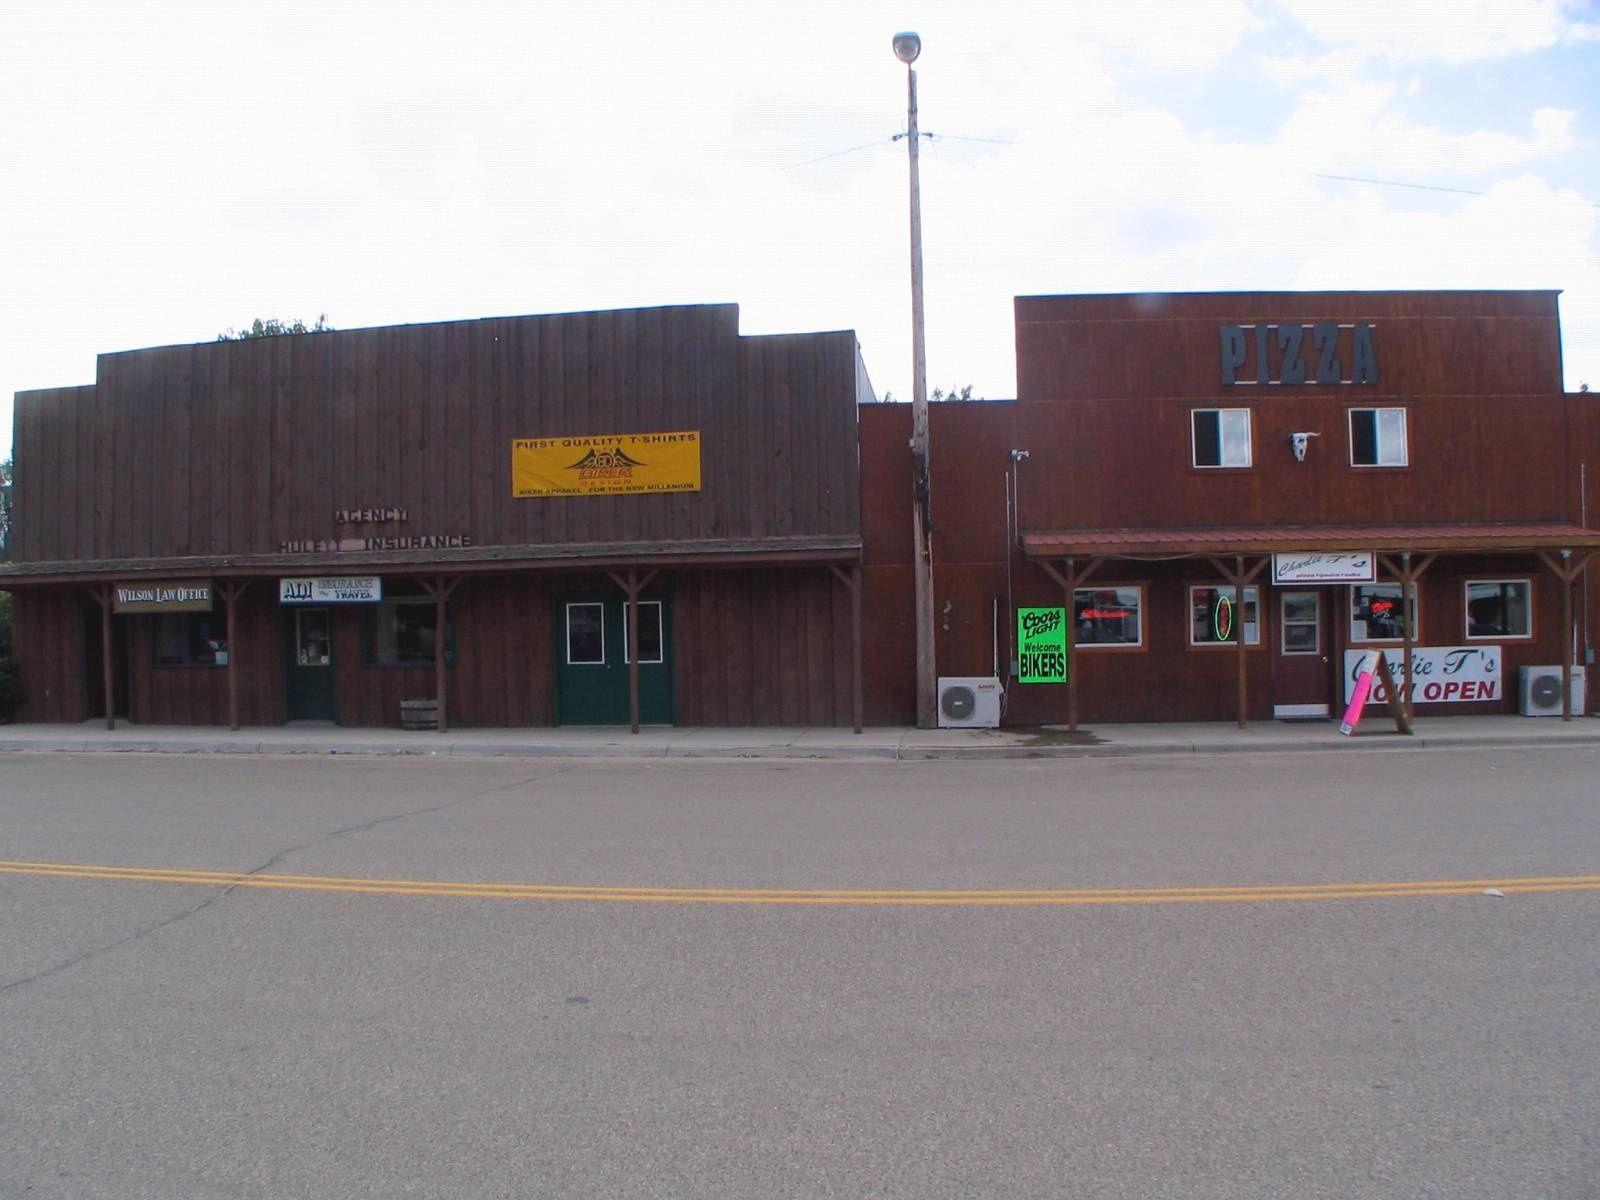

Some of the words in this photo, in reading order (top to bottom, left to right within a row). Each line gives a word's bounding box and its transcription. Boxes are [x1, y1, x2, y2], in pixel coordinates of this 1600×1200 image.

[1219, 324, 1380, 385] PIZZA
[516, 440, 556, 449] FIRST
[562, 437, 623, 448] QUALITY
[629, 433, 697, 443] T-SHIRTS
[335, 508, 409, 523] AGENCY
[365, 535, 471, 550] INSURANCE
[118, 588, 154, 602] WILSON
[156, 587, 177, 602] LAW
[177, 586, 208, 602] OFFICE
[335, 589, 373, 599] TRAVEL
[1022, 609, 1061, 630] Coors
[1025, 621, 1060, 640] LIGHT
[1024, 642, 1061, 653] Welcome
[1020, 652, 1065, 678] BIKERS
[1444, 649, 1495, 675] T's
[1424, 681, 1496, 700] OPEN
